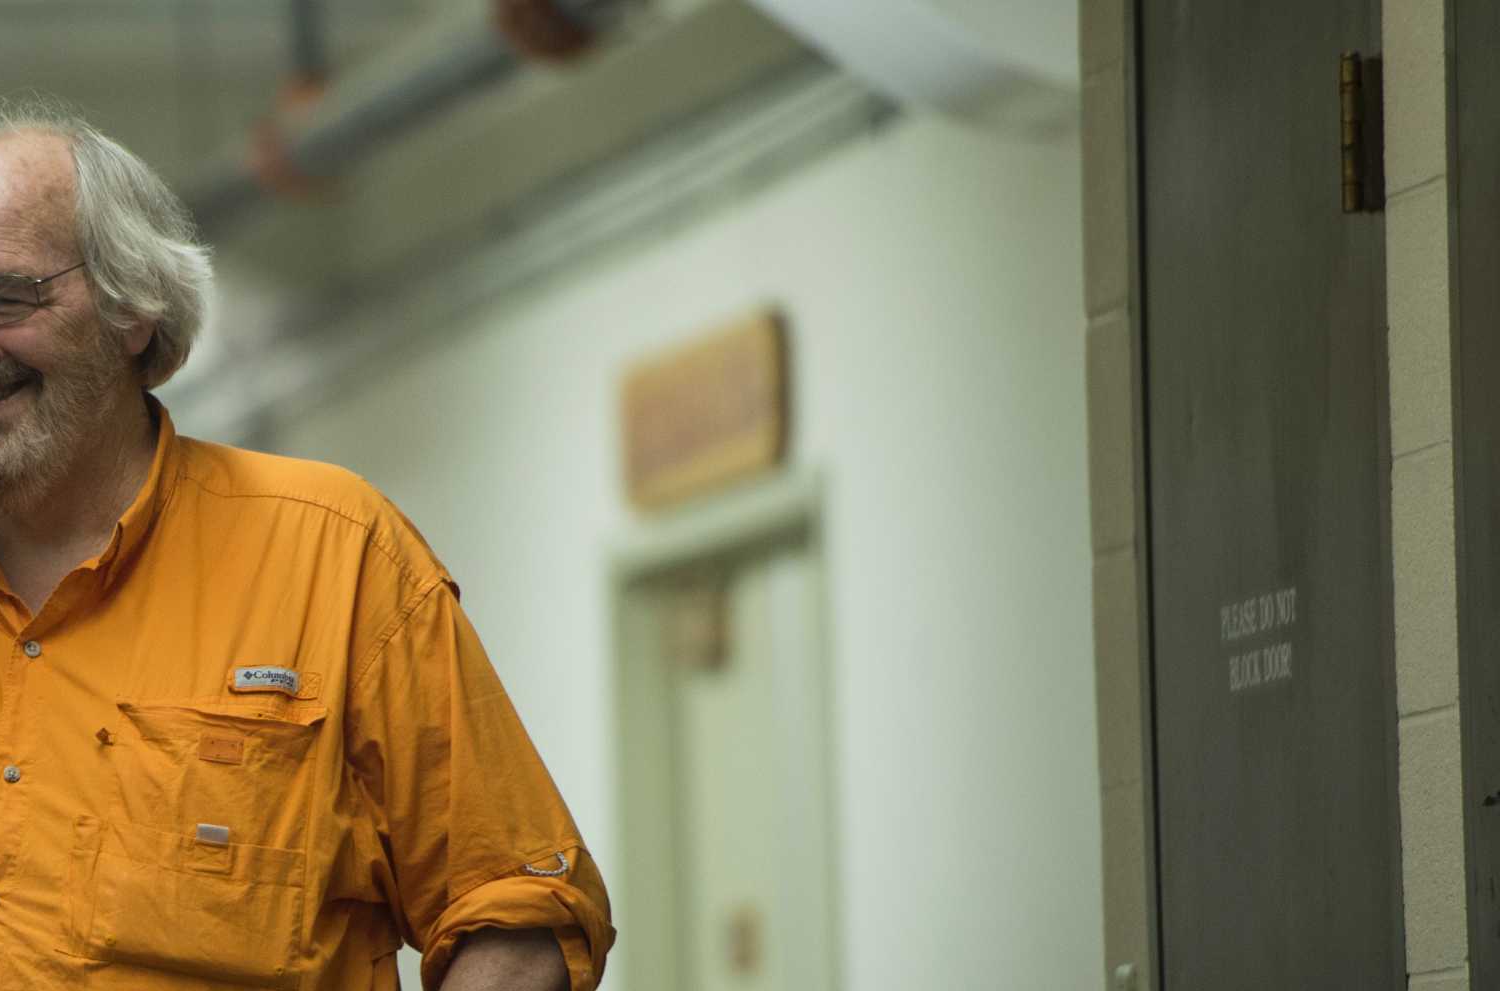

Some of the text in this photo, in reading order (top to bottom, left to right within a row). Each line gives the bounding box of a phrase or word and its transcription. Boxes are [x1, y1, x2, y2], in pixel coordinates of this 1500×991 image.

[1220, 587, 1297, 640] PLEASE DO NOT
[1229, 650, 1261, 692] BLOCK
